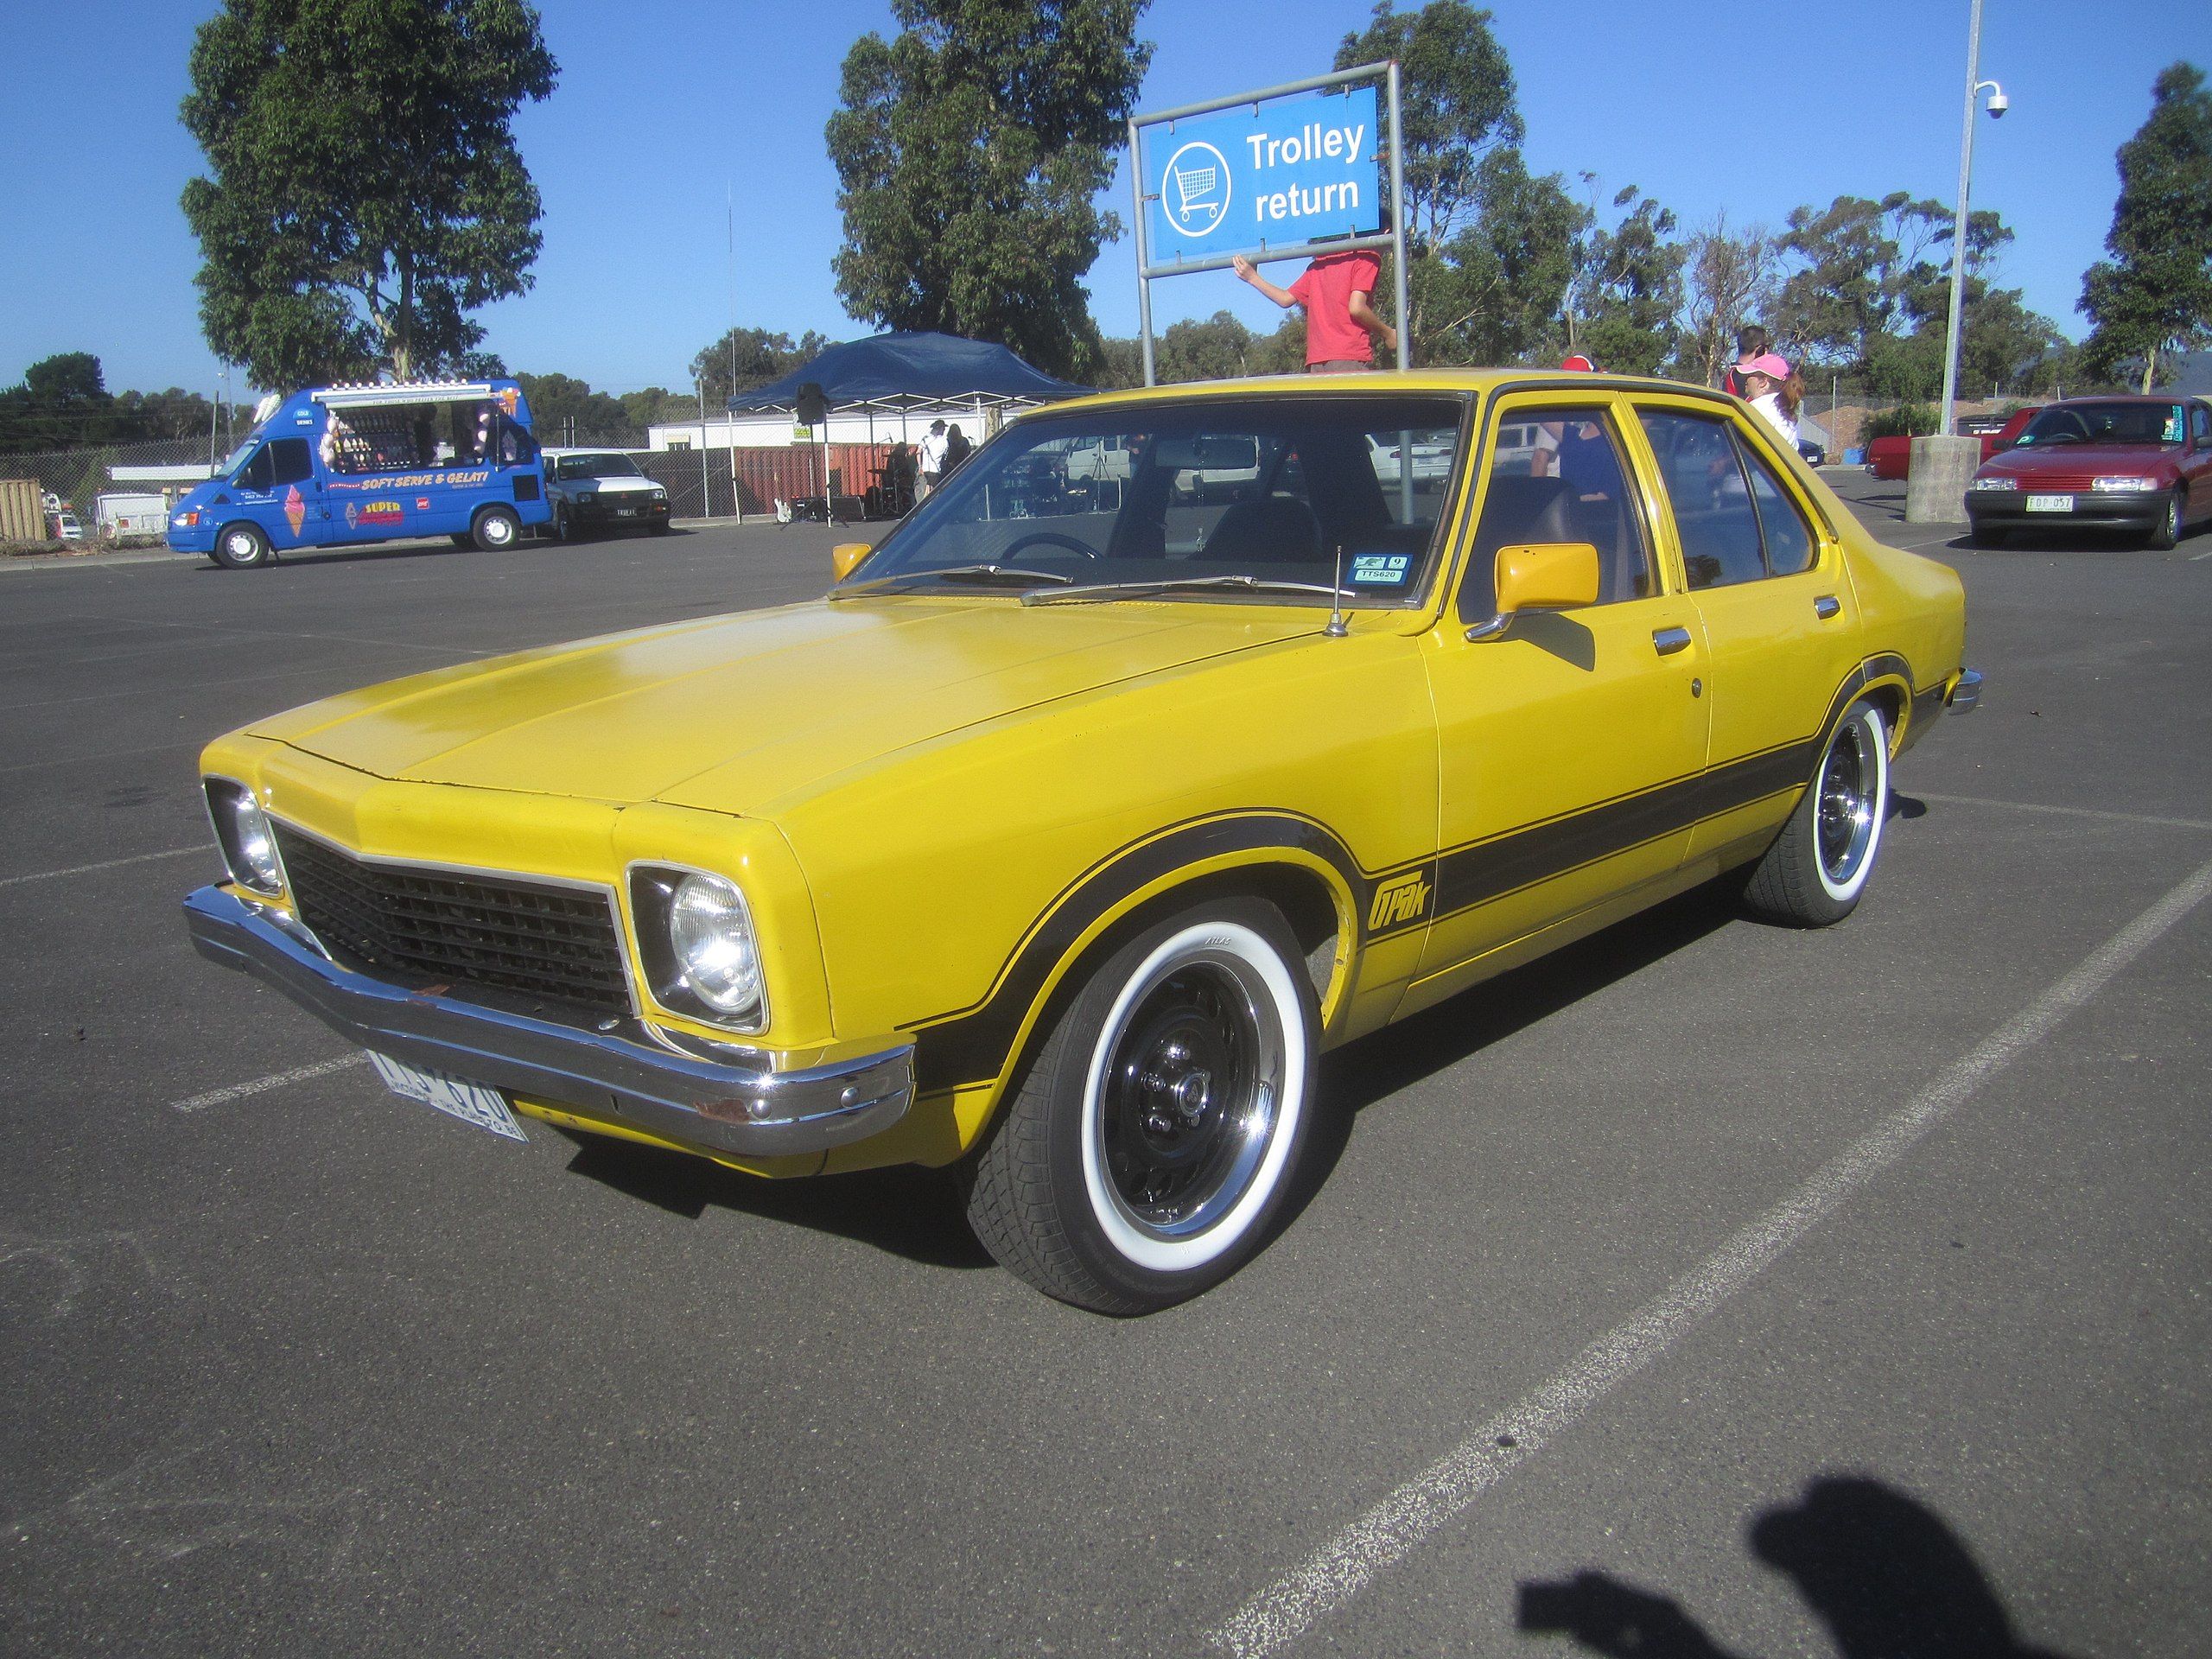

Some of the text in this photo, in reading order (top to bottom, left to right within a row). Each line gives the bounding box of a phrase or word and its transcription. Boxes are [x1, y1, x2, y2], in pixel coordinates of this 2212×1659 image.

[1247, 124, 1365, 169] Trolley
[1255, 181, 1358, 222] return
[361, 479, 395, 491] SOFT
[395, 474, 433, 487] SERVE
[435, 474, 445, 484] &
[447, 471, 489, 484] GELATI
[365, 501, 400, 513] SUPER
[1205, 936, 1231, 945] ATLAS
